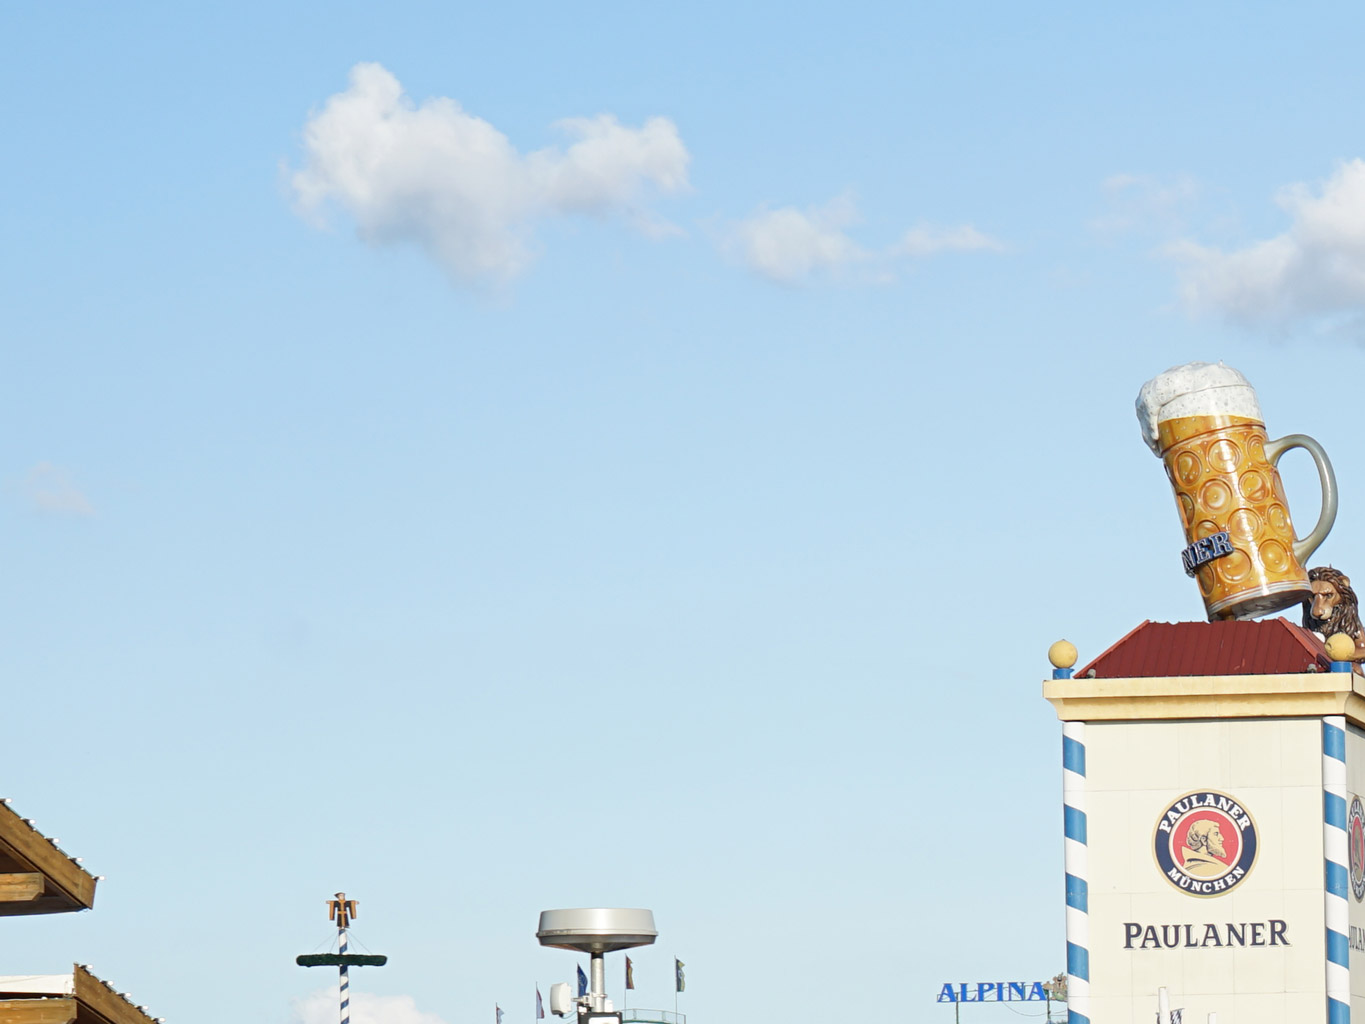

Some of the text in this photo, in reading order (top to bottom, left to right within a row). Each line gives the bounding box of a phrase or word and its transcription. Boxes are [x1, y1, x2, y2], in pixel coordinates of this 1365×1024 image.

[1158, 794, 1250, 834] PAULANER
[1167, 866, 1245, 893] MÜNCHEN
[1122, 919, 1292, 950] PAULANER
[937, 981, 1047, 1003] ALPINA
